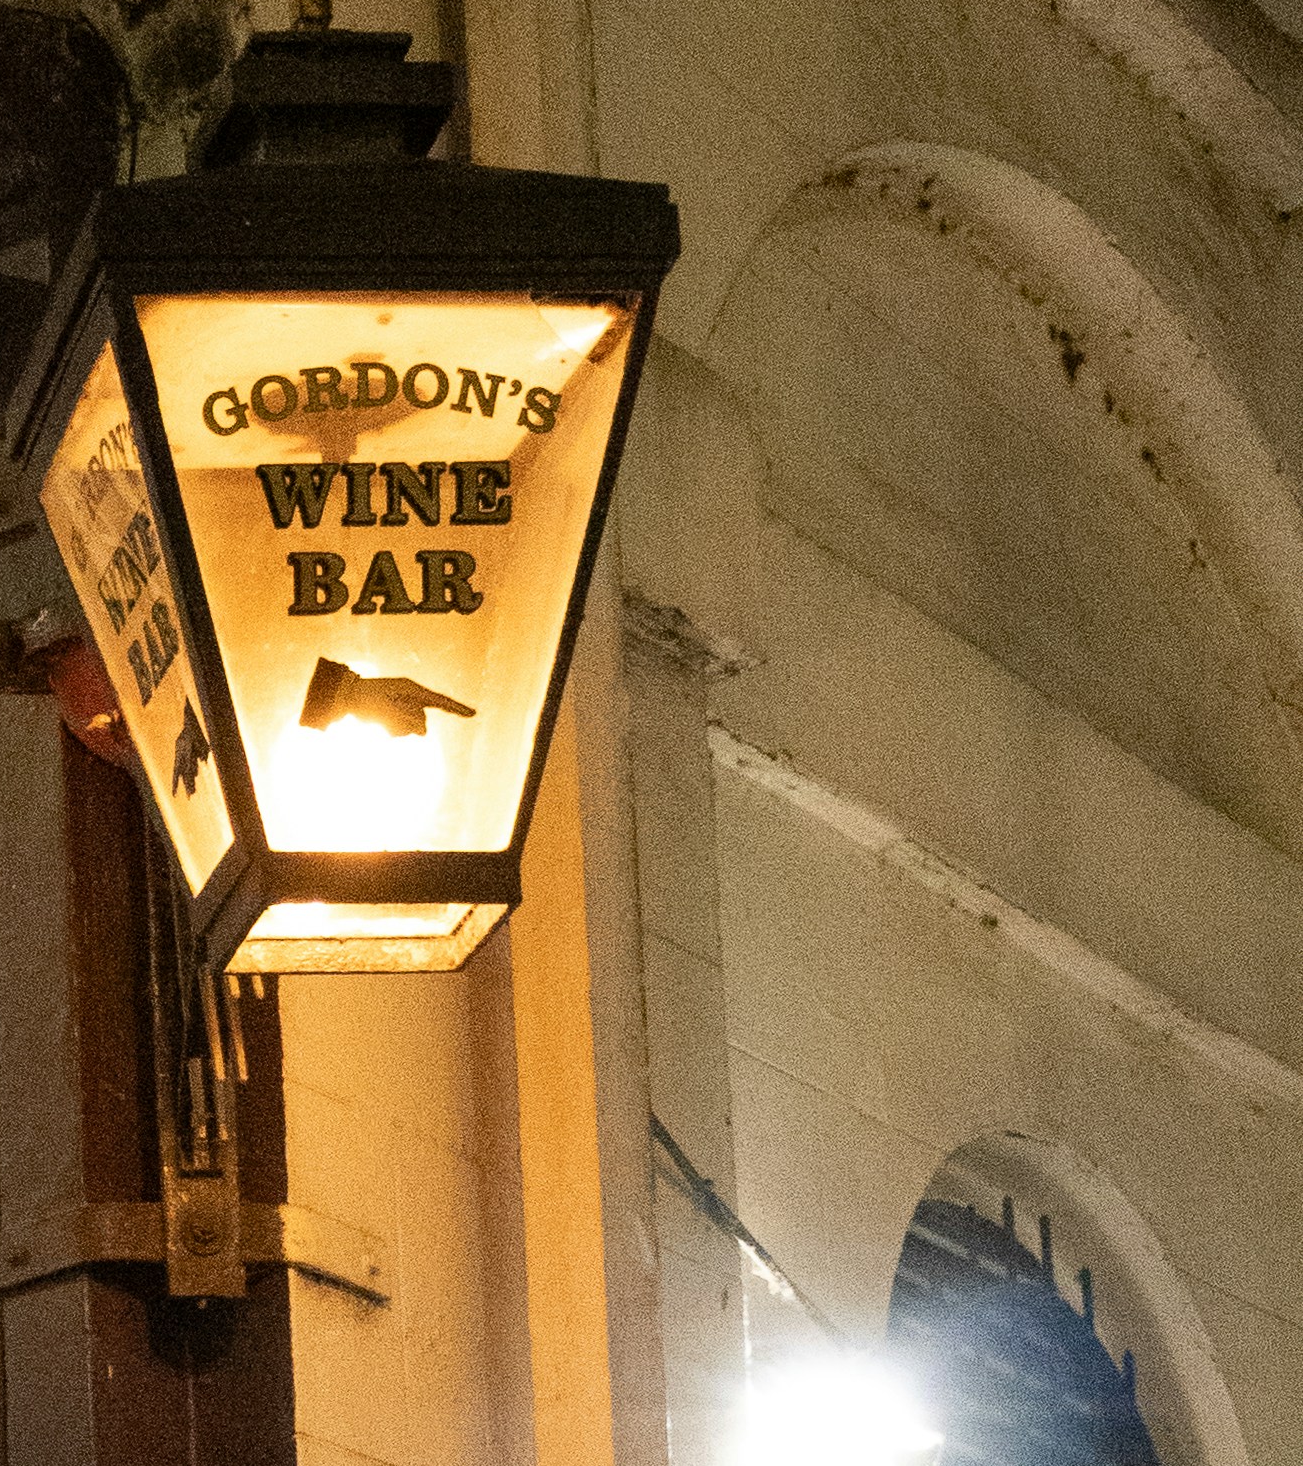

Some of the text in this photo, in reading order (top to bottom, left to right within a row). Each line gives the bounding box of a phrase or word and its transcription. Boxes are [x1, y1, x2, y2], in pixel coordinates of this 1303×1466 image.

[203, 360, 562, 436] GORDON'S
[255, 460, 513, 527] WINE
[286, 549, 485, 617] BAR
